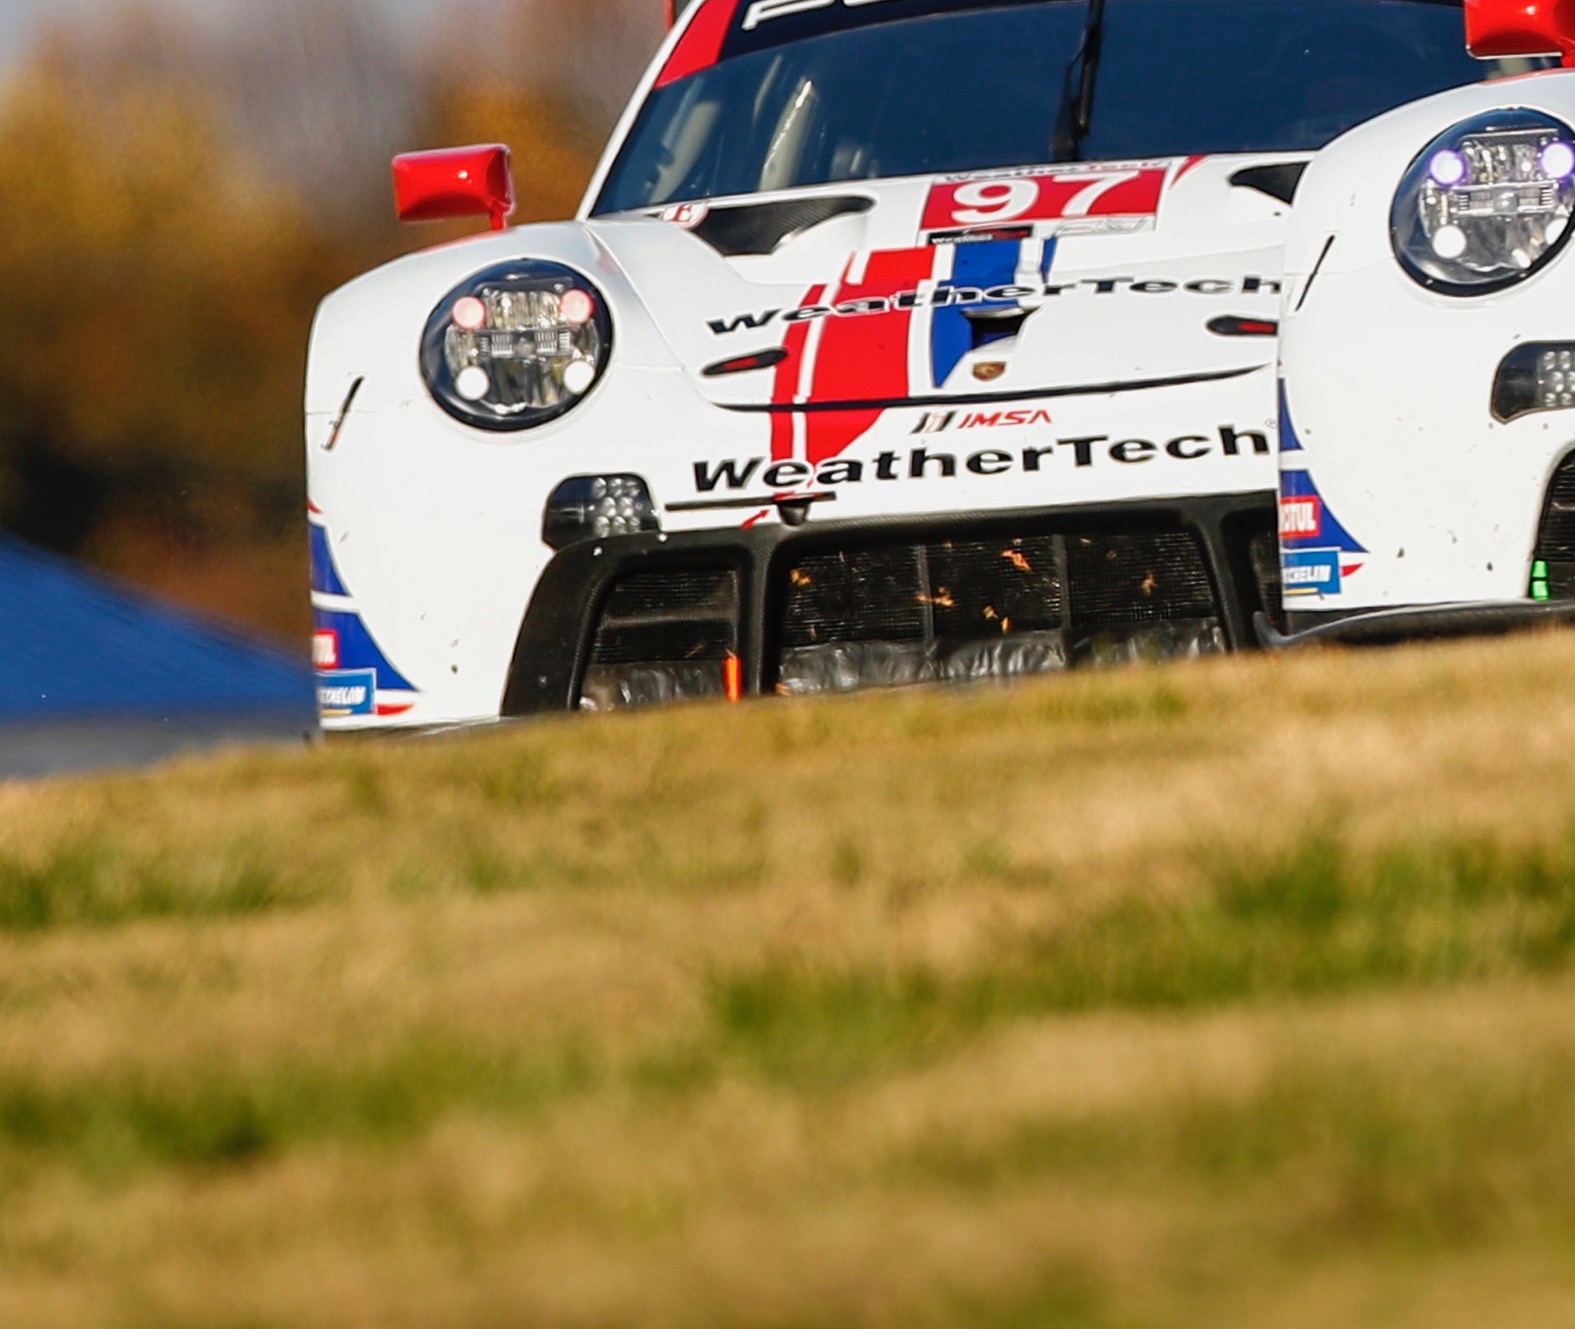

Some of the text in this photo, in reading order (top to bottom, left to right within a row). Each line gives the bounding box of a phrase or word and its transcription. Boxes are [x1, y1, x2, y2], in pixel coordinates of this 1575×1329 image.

[951, 170, 1140, 224] 97
[706, 276, 1280, 335] WeatherTech
[957, 408, 1053, 431] IMSA
[692, 423, 1272, 493] WeatherTech
